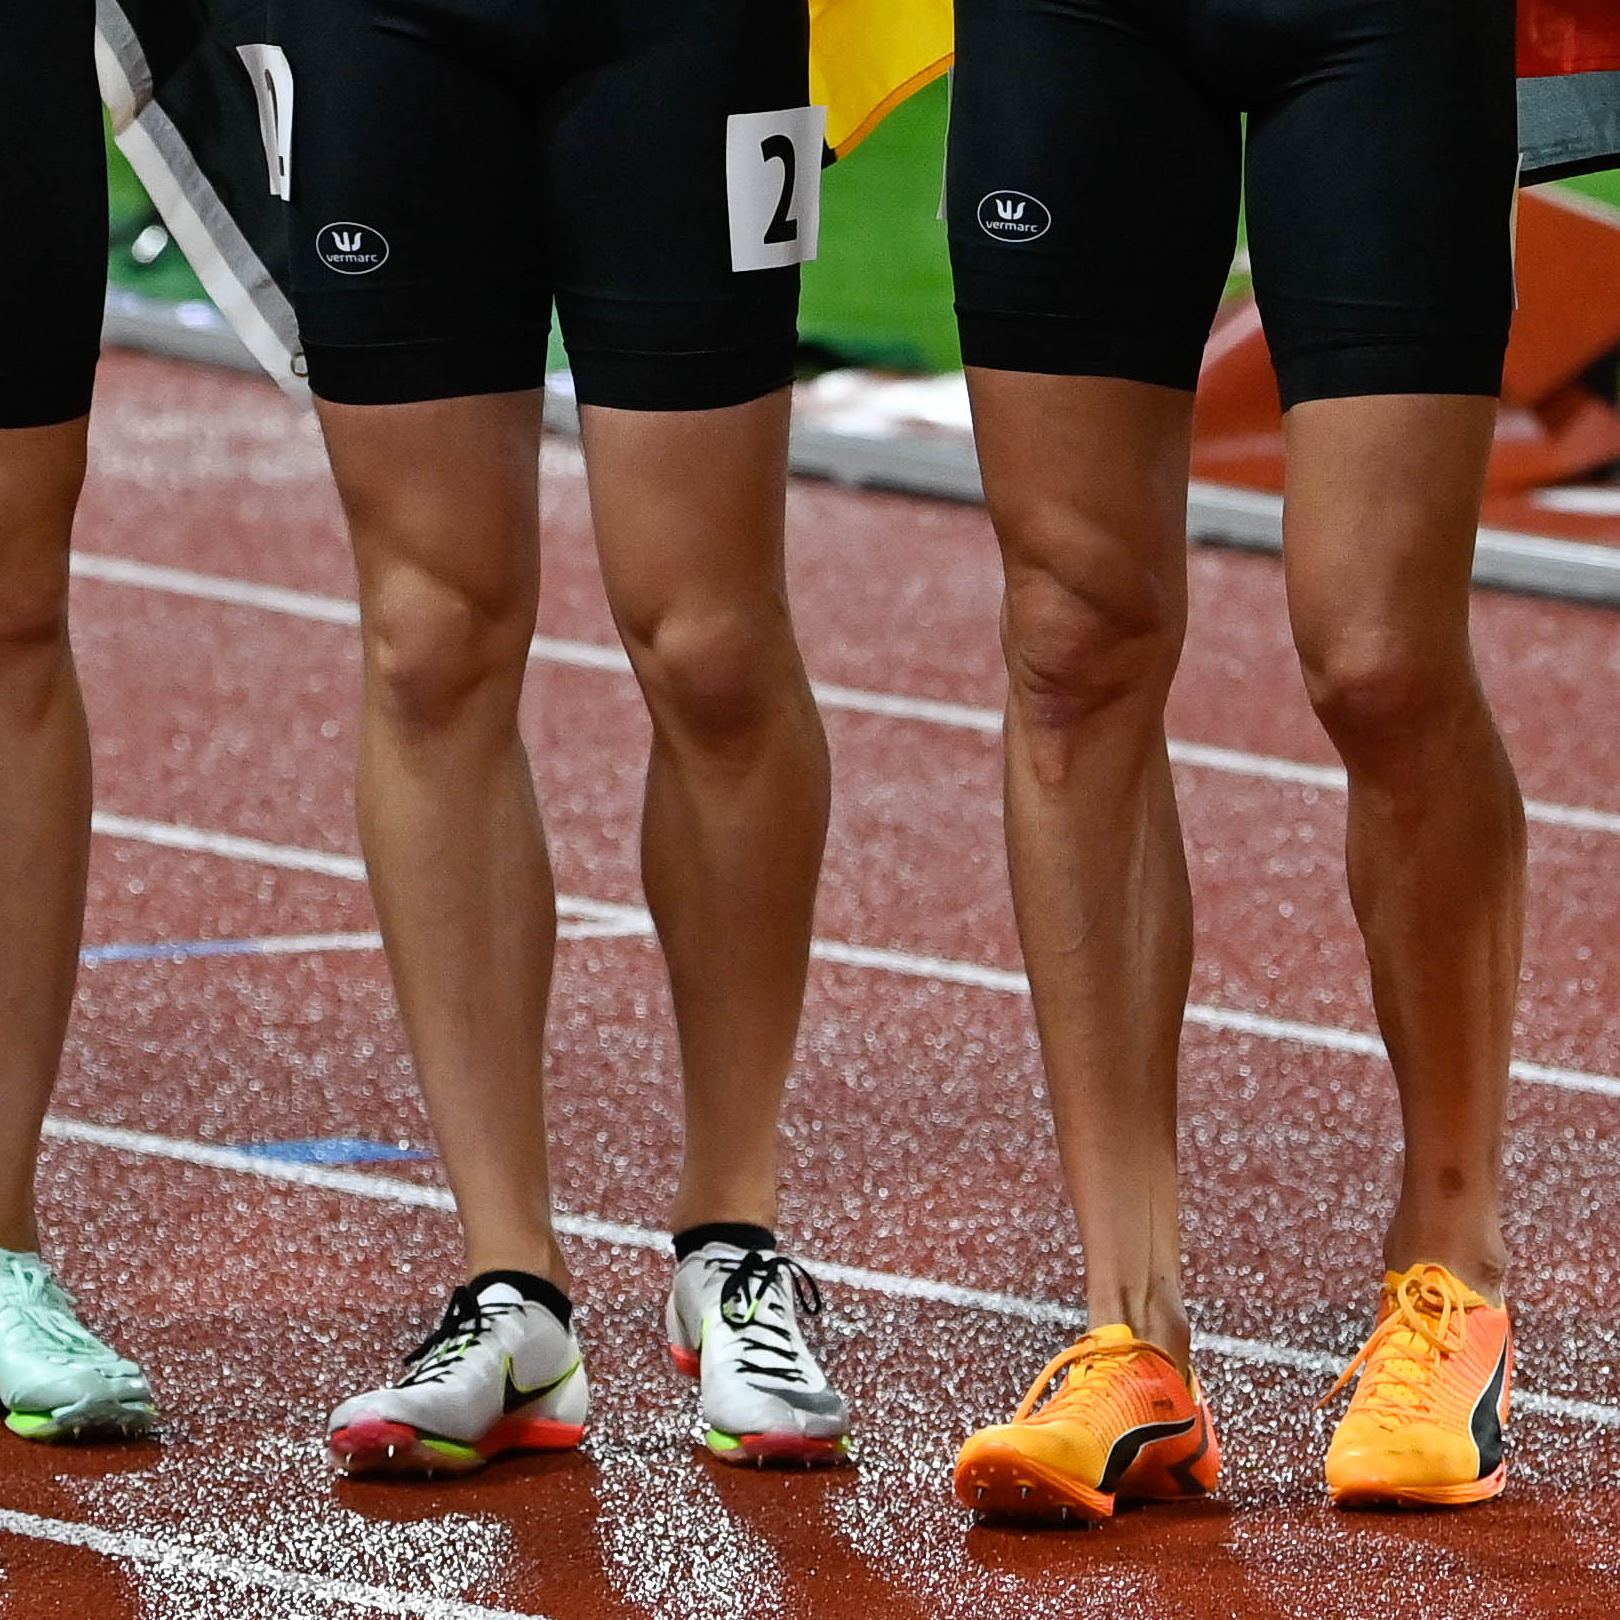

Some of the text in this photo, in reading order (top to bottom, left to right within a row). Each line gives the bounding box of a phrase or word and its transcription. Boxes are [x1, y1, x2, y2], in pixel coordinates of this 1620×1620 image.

[760, 134, 797, 245] 2
[985, 220, 1039, 233] vermarc
[325, 253, 379, 263] vermarc
